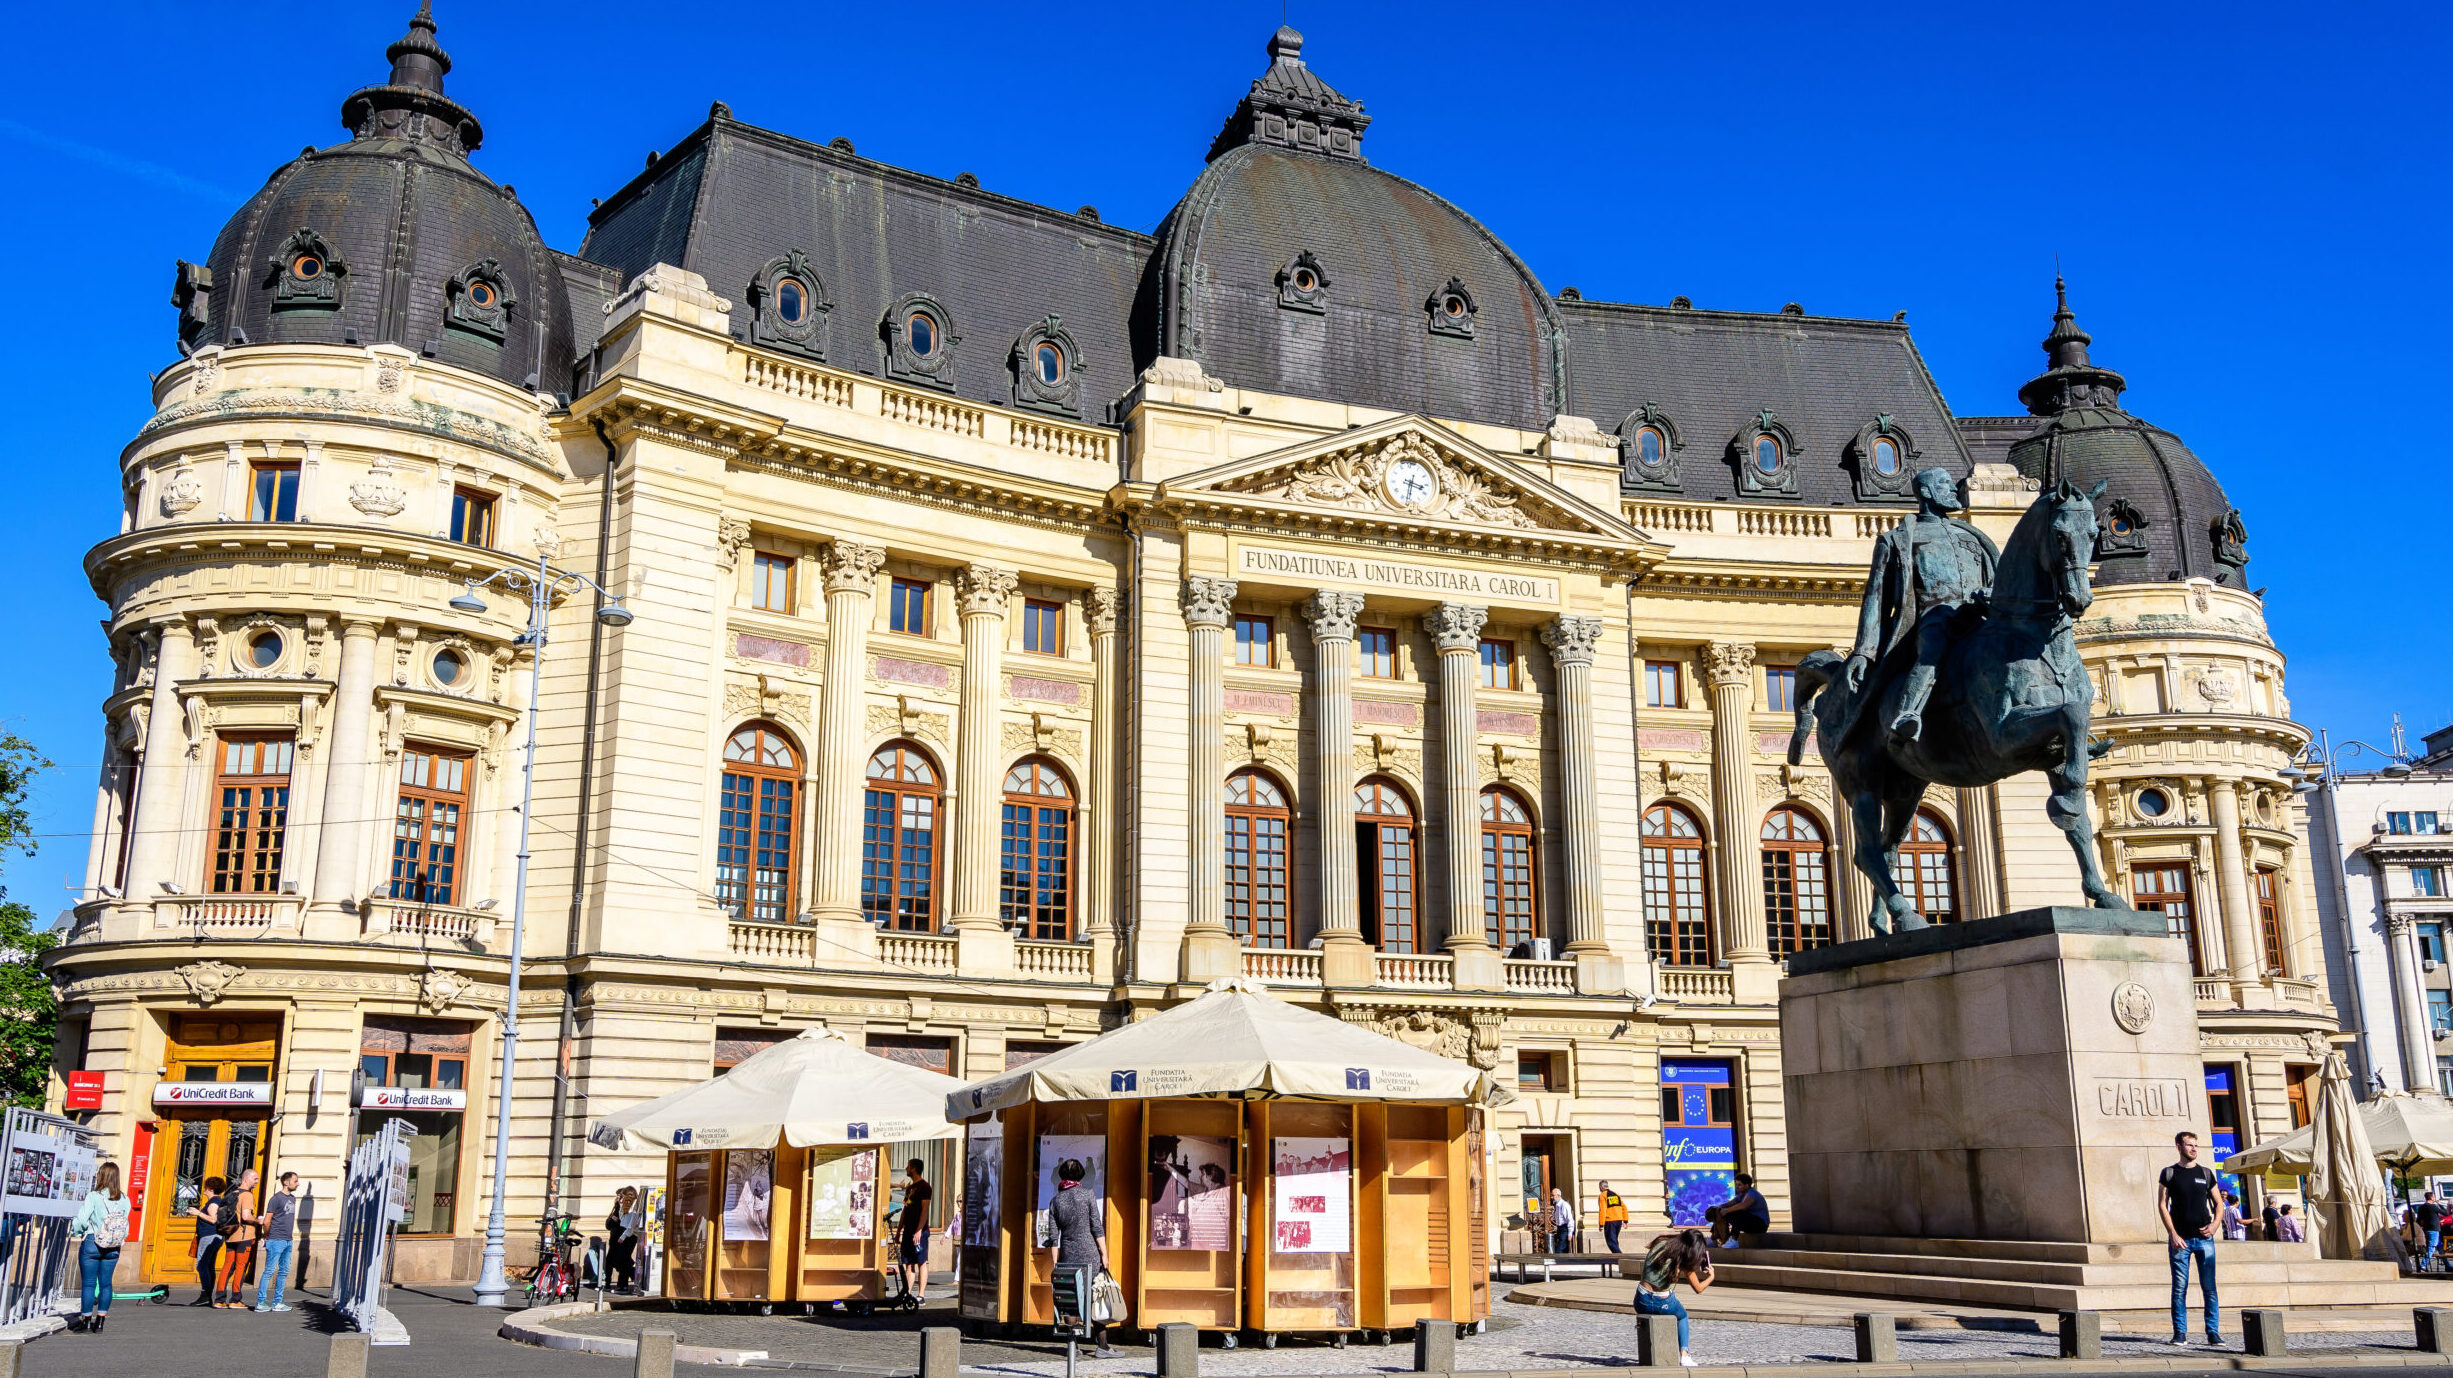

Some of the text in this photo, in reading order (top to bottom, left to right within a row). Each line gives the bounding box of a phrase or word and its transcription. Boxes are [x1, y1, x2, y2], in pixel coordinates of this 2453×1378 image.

[1245, 551, 1553, 599] FUNDATIUNEA UNIVERSITARA CAROL I
[183, 1087, 255, 1099] UniCredit Bank
[389, 1093, 453, 1106] UniCredit Bank
[2098, 1083, 2187, 1117] CAROL I
[2213, 1146, 2233, 1154] OPA
